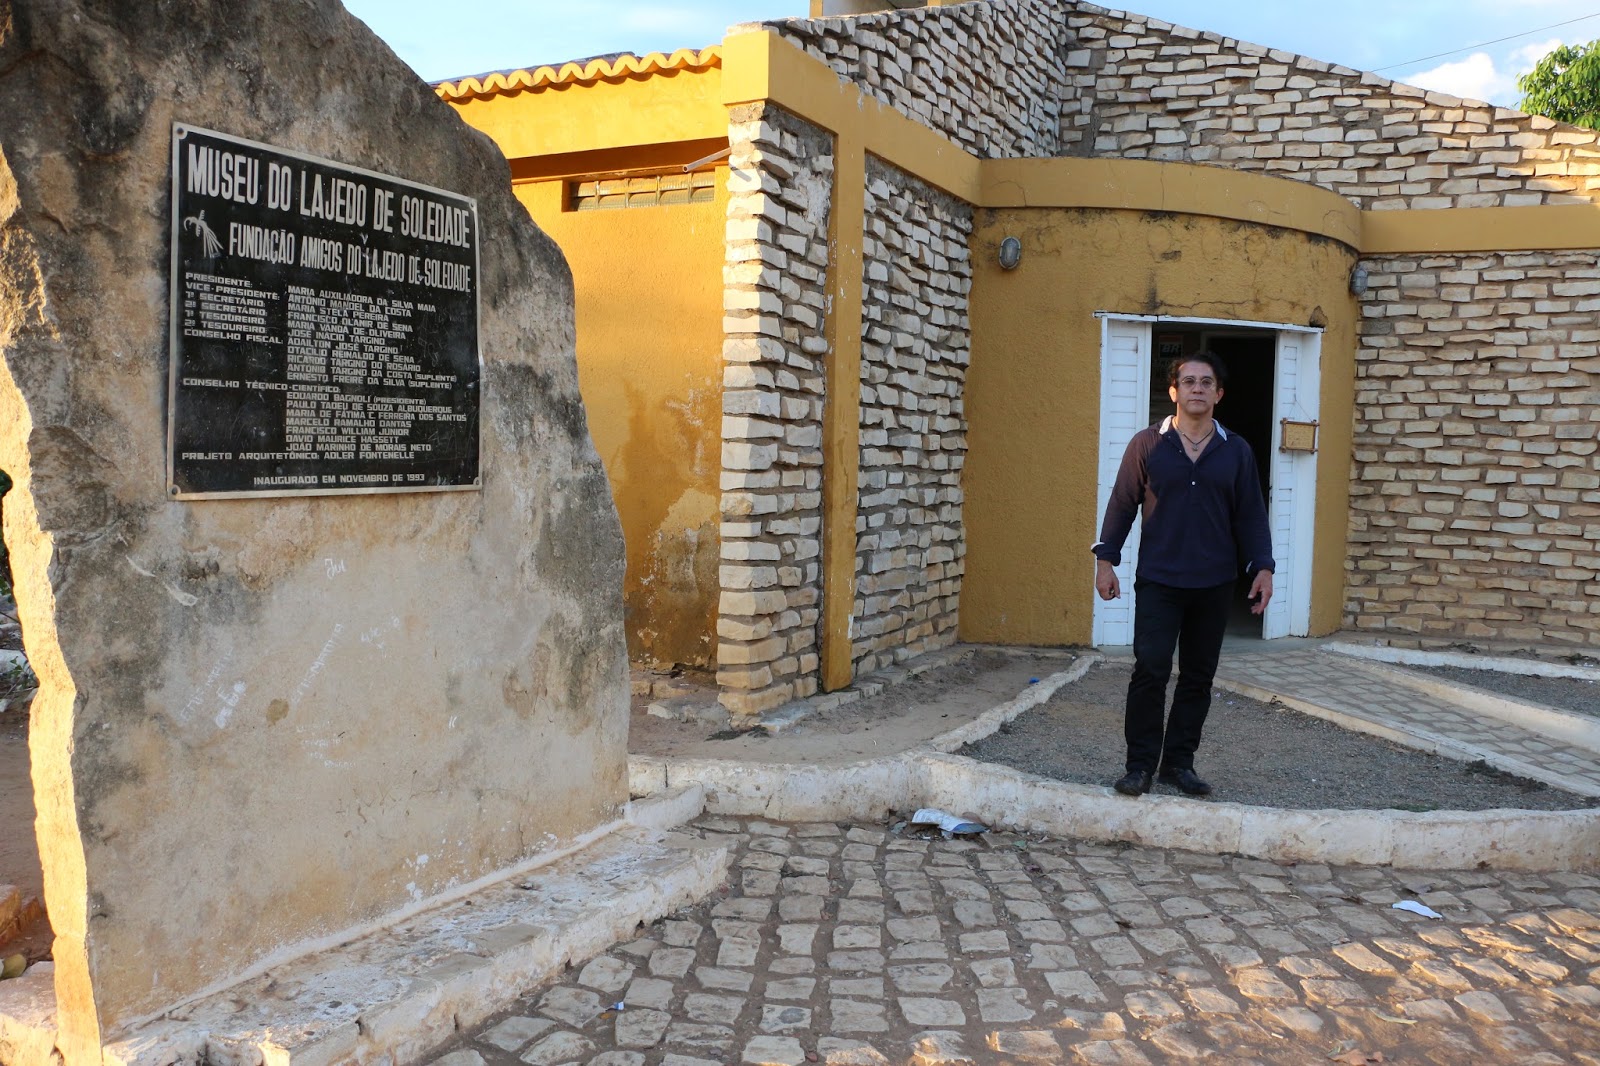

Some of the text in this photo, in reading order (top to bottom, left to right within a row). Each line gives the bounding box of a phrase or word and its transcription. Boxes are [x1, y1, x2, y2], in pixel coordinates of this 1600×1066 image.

[188, 144, 470, 249] MUSEU DO LAJEDO DE SOLEDADE
[229, 222, 470, 292] FUNDAÇÃO AMIGOS DO LAJEDO DE SOLEDADE
[186, 272, 252, 287] PRESIDENTE:
[200, 293, 265, 307] SECRETÁRIO:
[288, 285, 436, 312] MARIA AUXILIADORA DA SILVA MAIA
[202, 302, 267, 316] SECRETÁRIO:
[288, 303, 388, 321] MARIA STELA PEREIRA
[330, 300, 364, 311] MANOEL
[369, 304, 381, 313] DA
[385, 307, 411, 317] COSTA
[199, 311, 266, 324] TESOUREIRO:
[288, 312, 337, 324] FRANCISCO
[392, 323, 413, 332] SENA
[201, 321, 267, 333] TESOUREIRO:
[288, 320, 315, 330] MARIA
[320, 324, 349, 334] VANDA
[369, 329, 406, 339] OLIVEIRA
[184, 329, 240, 340] CONSELHO
[349, 335, 385, 345] TARGINO
[288, 338, 331, 348] ADAILTON
[364, 345, 398, 354] TARGINO
[332, 350, 374, 360] REINALDO
[287, 354, 326, 365] RICARDO
[330, 358, 366, 367] TARGINO
[387, 362, 420, 371] ROSÁRIO
[331, 367, 367, 376] TARGINO
[415, 373, 457, 382] (SUPLENTE)
[183, 378, 239, 388] CONSELHO
[333, 375, 363, 384] FREIRE
[408, 381, 452, 389] (SUPLENTE)
[287, 392, 329, 400] EDUARDO
[374, 396, 426, 405] (PRESIDENTE)
[287, 400, 316, 408] PAULO
[398, 405, 452, 413] ALBUQUERQUE
[286, 443, 311, 451] JOÃO
[239, 451, 319, 460] ARQUITETÔNICO:
[254, 476, 318, 485] INAUGURADO
